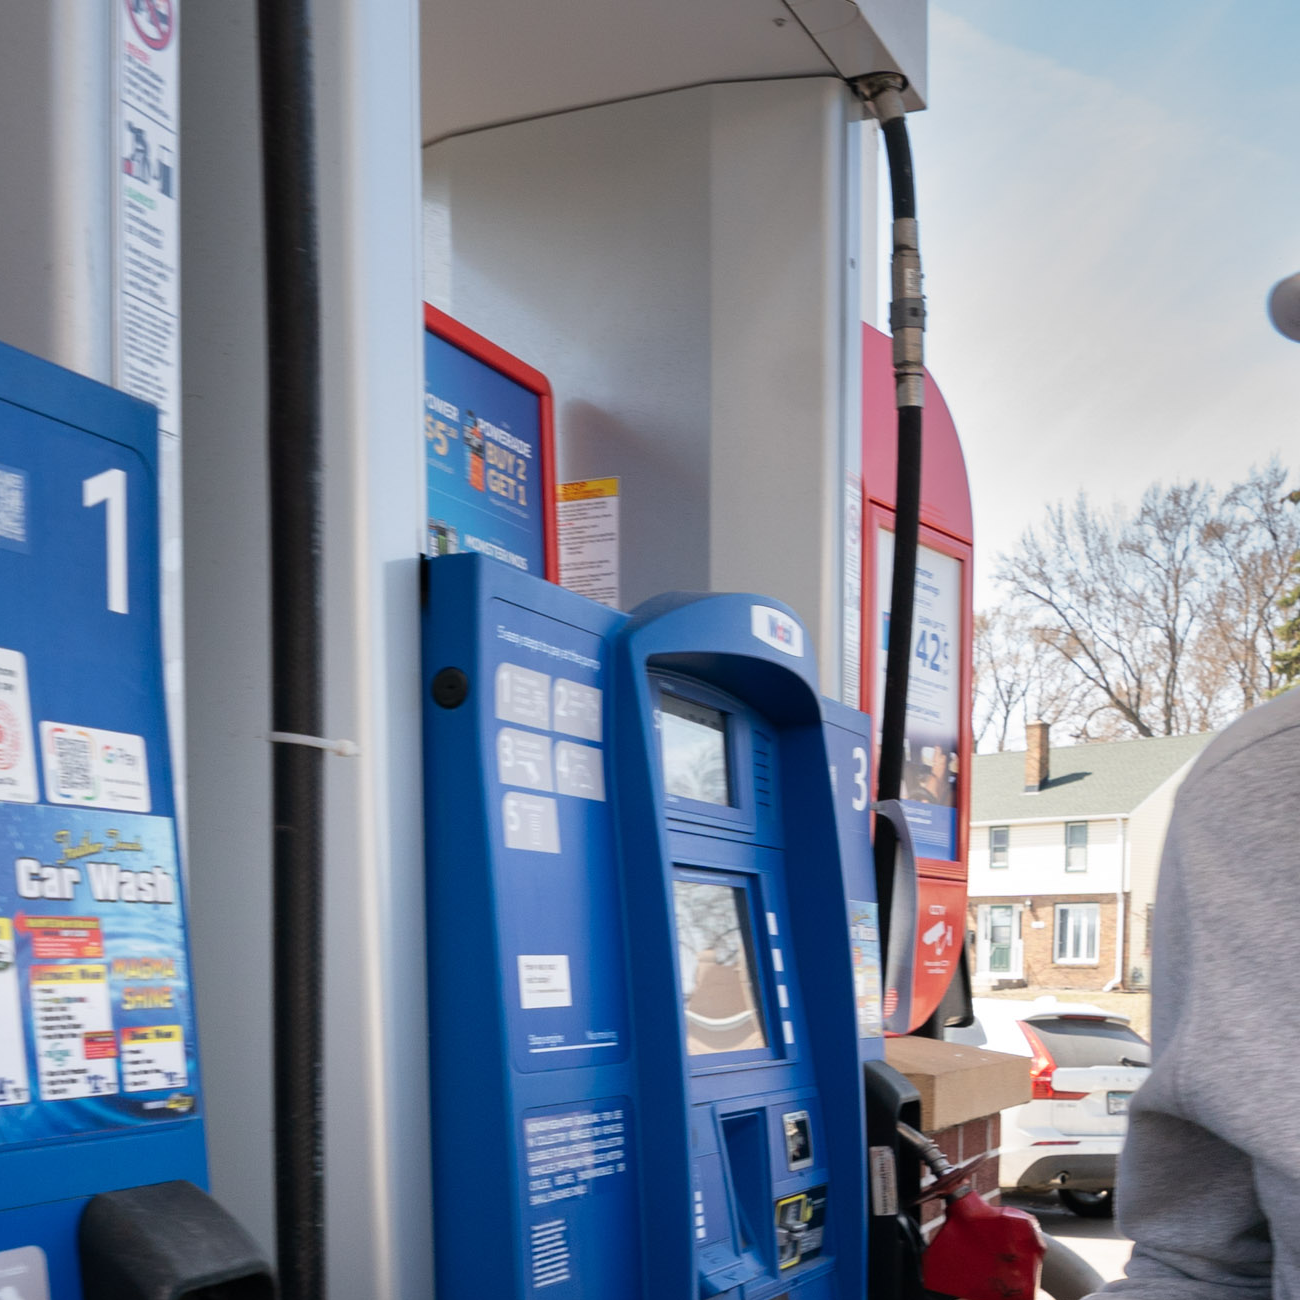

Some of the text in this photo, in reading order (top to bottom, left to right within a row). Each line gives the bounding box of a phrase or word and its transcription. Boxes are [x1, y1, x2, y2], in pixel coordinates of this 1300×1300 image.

[487, 469, 517, 500] GET
[82, 468, 129, 615] 1
[852, 746, 868, 812] 3
[15, 856, 81, 901] Car
[86, 861, 174, 904] Wash
